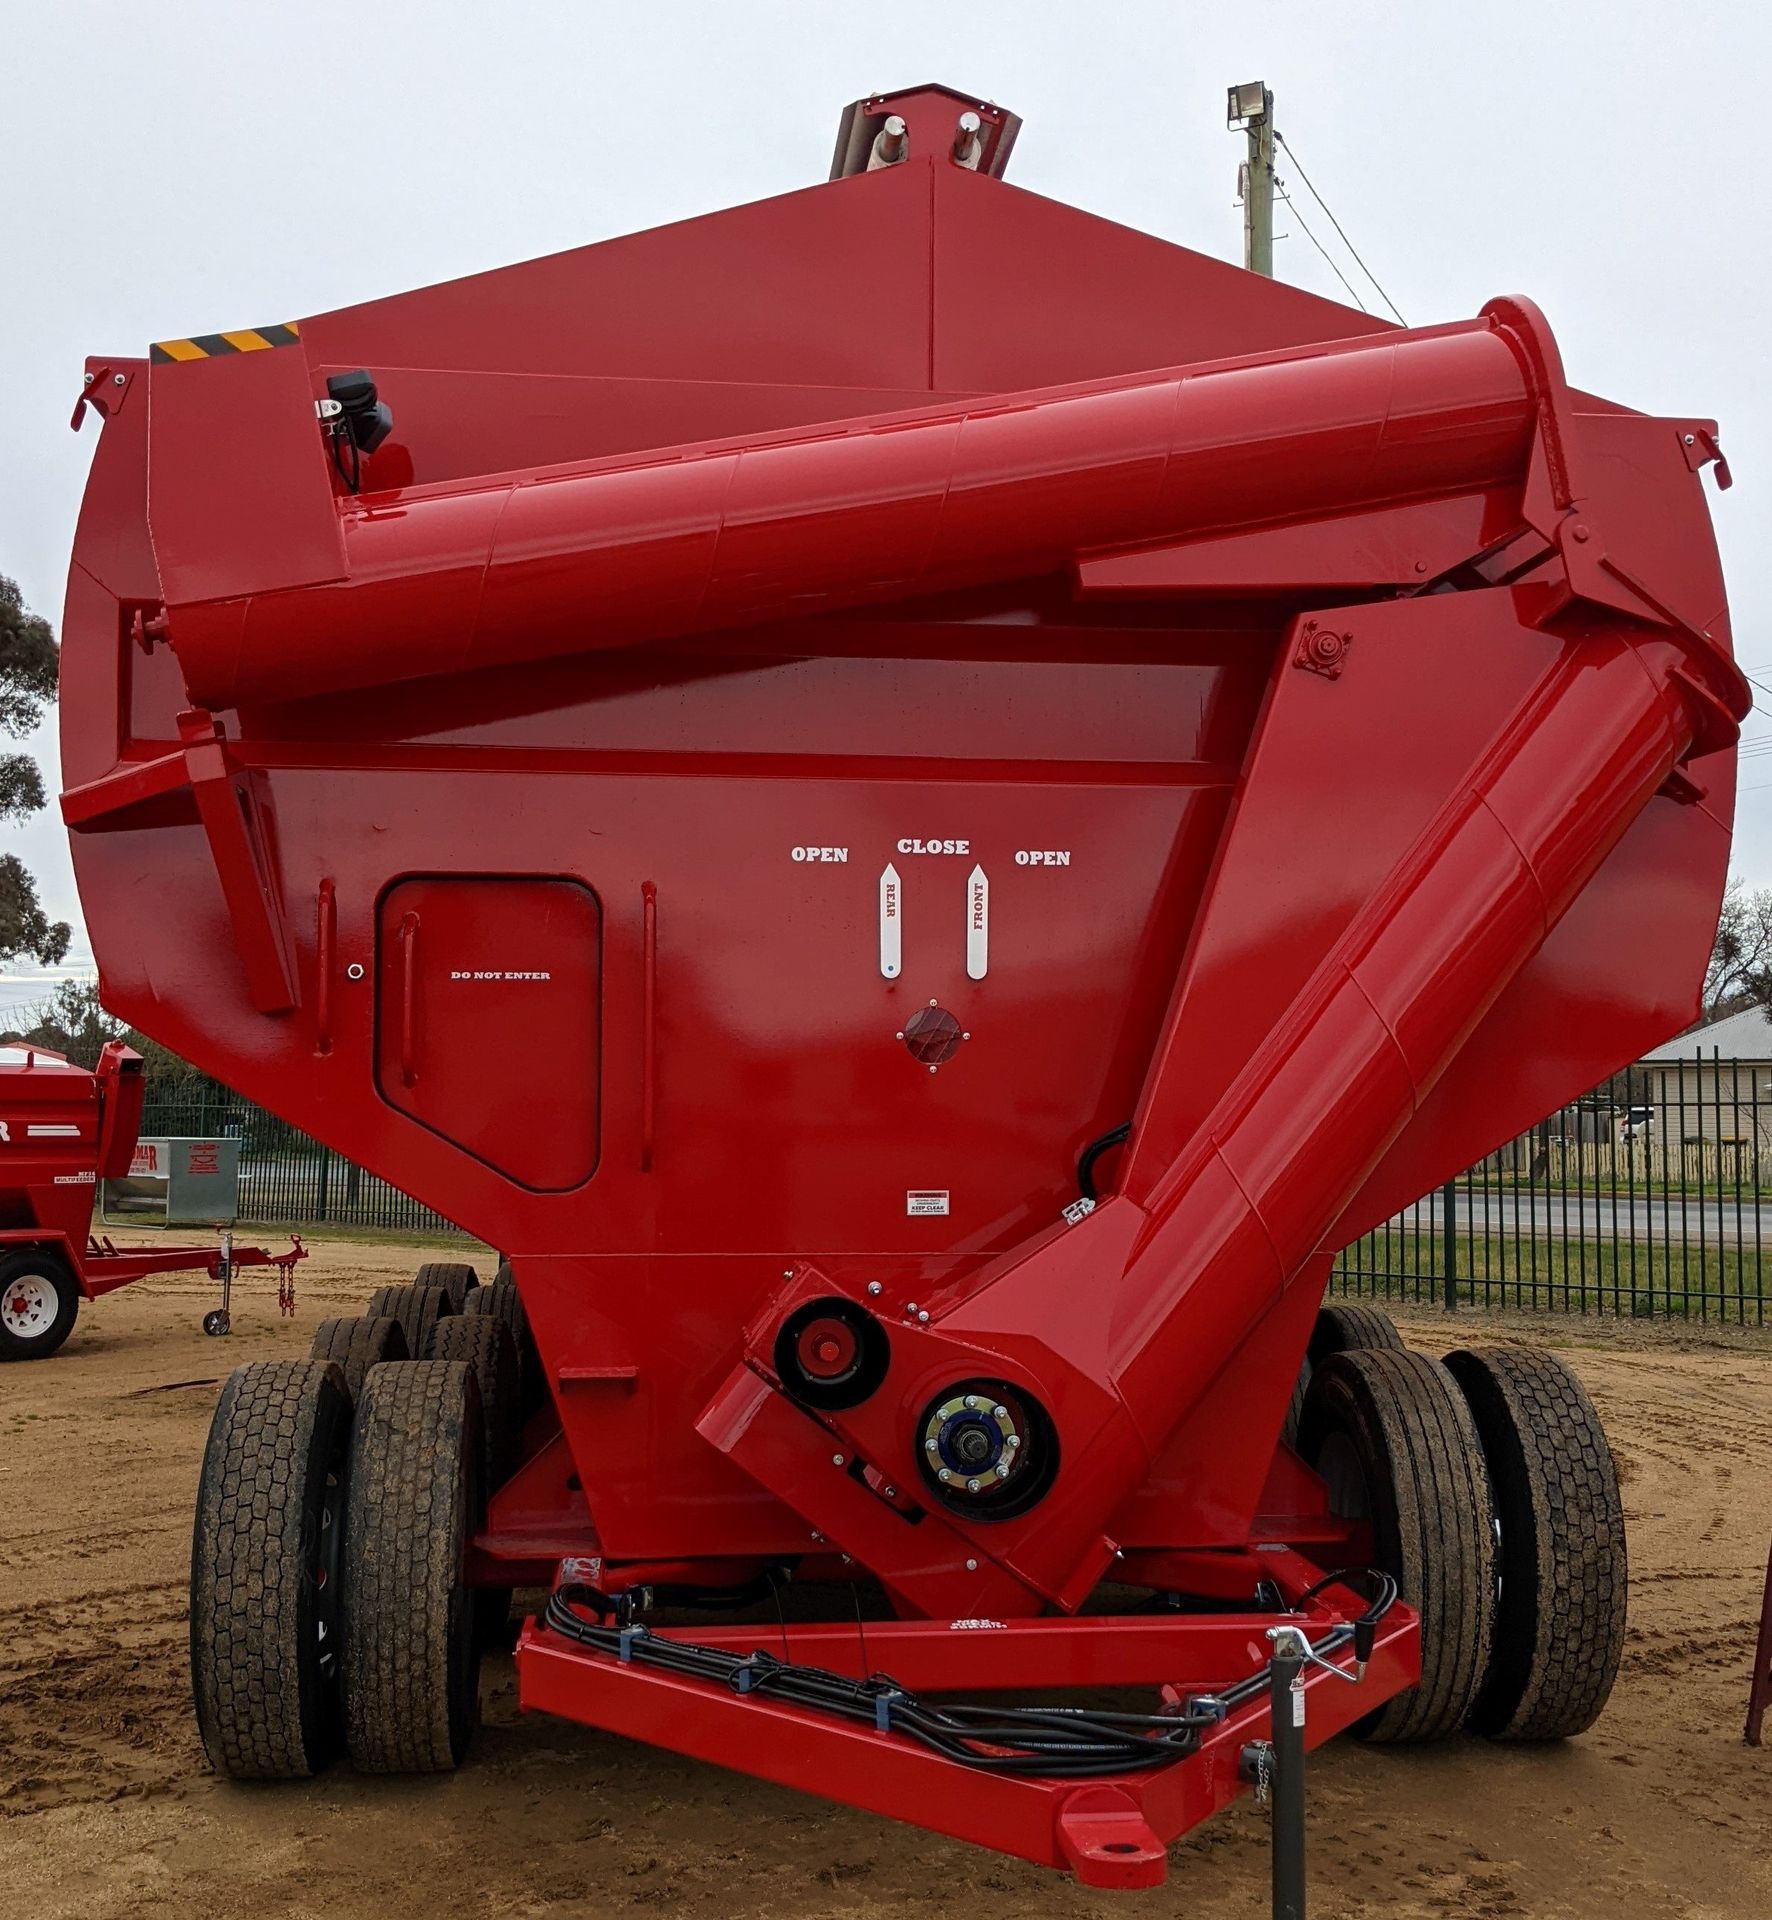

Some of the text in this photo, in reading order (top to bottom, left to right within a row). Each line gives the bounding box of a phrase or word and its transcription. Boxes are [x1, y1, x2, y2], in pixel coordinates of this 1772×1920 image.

[791, 847, 849, 862] OPEN
[897, 839, 970, 855] CLOSE
[1015, 851, 1070, 866] OPEN
[886, 884, 895, 918] REAR
[973, 883, 984, 930] FRONT
[505, 972, 550, 980] ENTER
